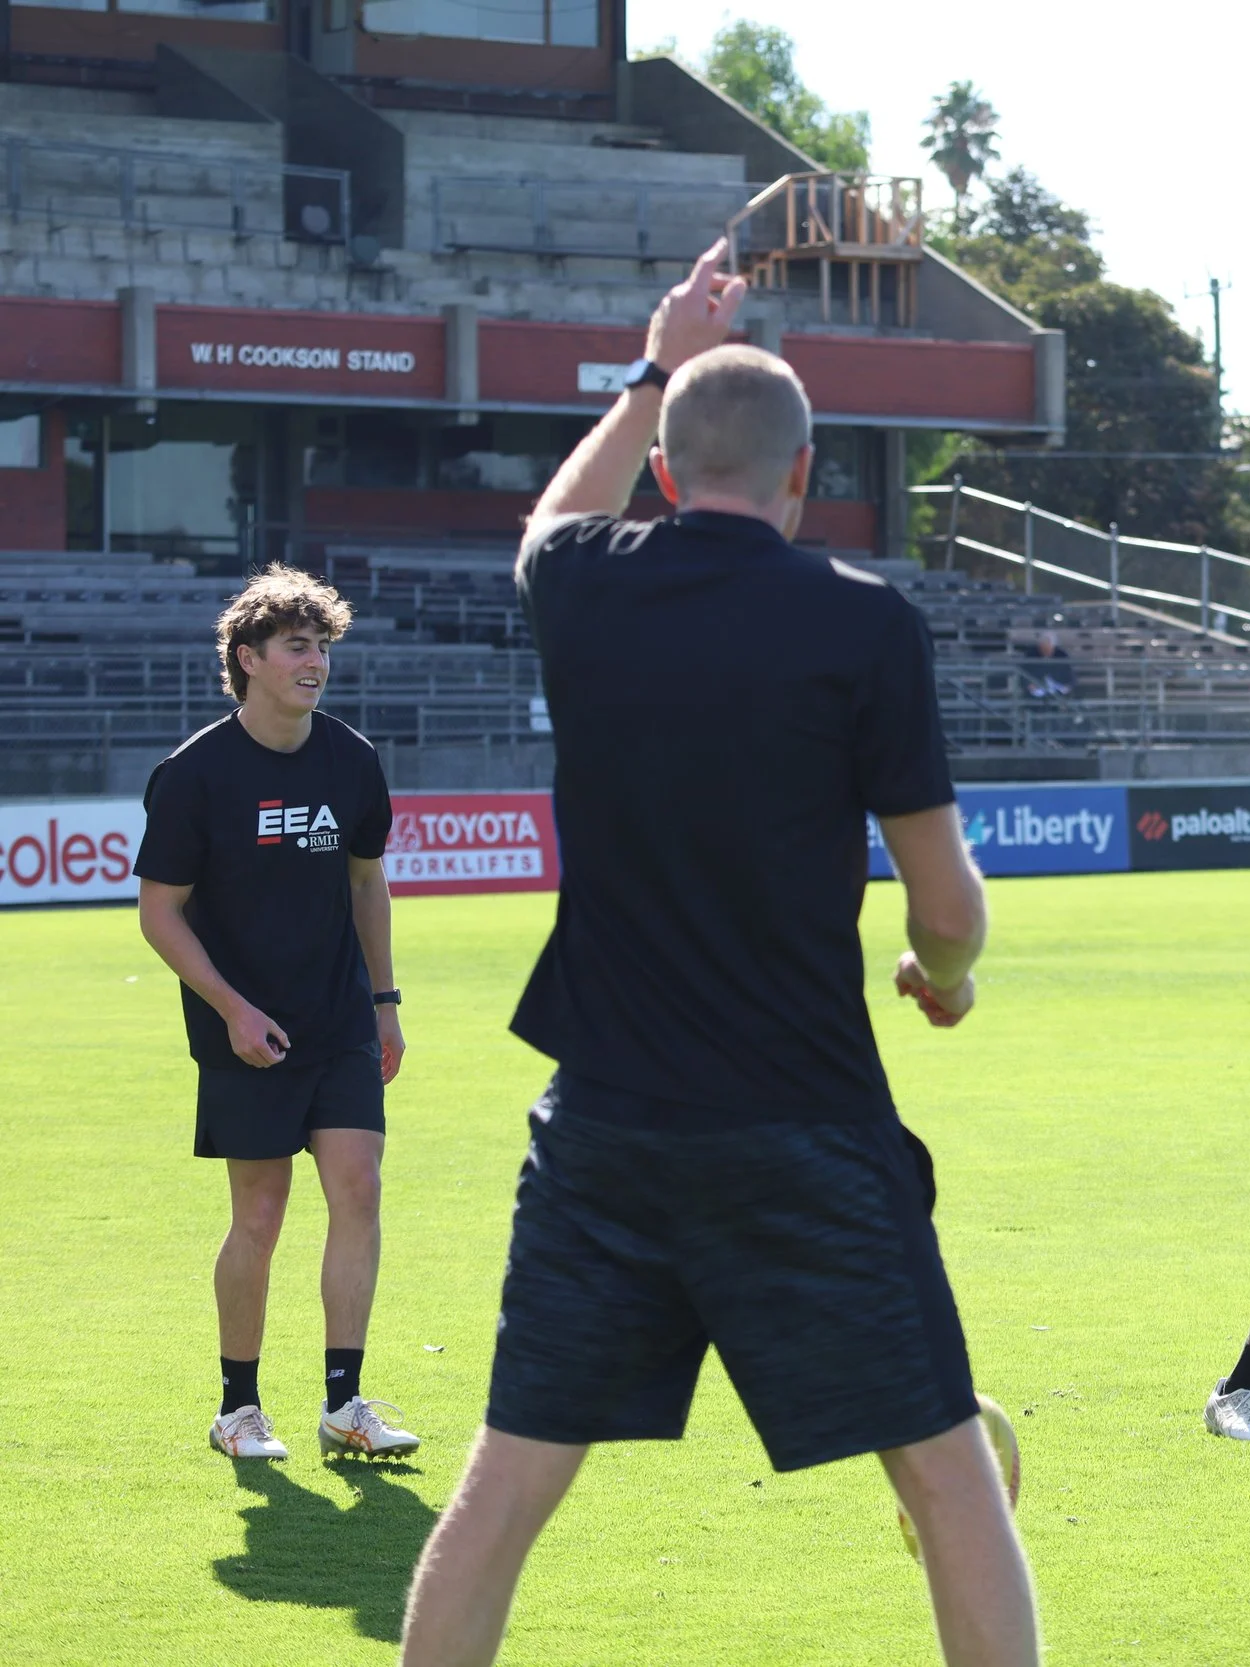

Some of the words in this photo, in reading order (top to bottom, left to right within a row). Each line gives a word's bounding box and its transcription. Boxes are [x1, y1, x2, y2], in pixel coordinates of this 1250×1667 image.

[217, 344, 233, 364] H
[238, 345, 339, 368] COOKSON
[347, 350, 415, 372] STAND
[258, 804, 339, 835] EEA
[419, 812, 540, 845] TOYOTA
[997, 805, 1113, 853] Liberty
[0, 817, 131, 888] oles
[309, 834, 340, 847] RMIT
[396, 856, 532, 876] FORKLIFTS
